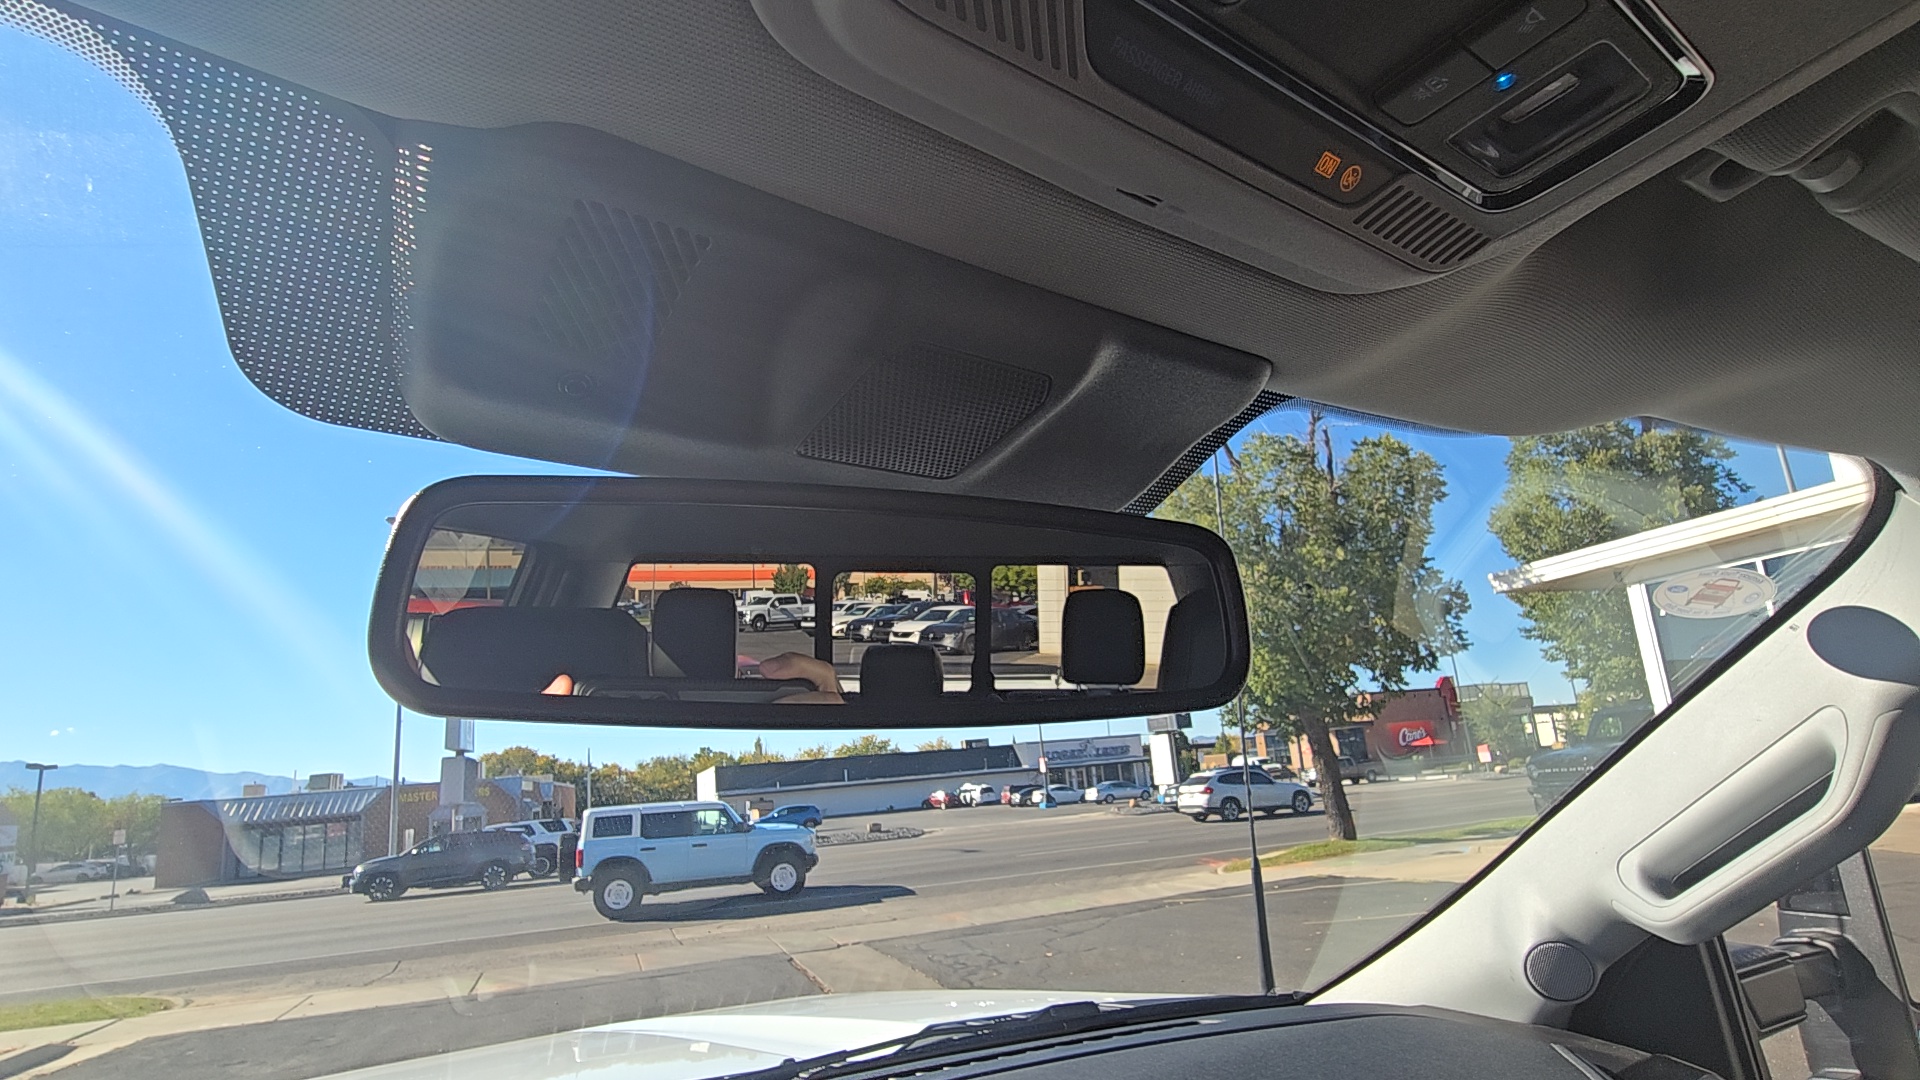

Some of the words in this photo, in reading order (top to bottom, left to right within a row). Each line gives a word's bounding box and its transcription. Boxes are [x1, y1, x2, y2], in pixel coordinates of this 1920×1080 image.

[1110, 36, 1184, 88] PASSENGER
[1319, 156, 1337, 174] ON
[398, 790, 438, 803] MASTER
